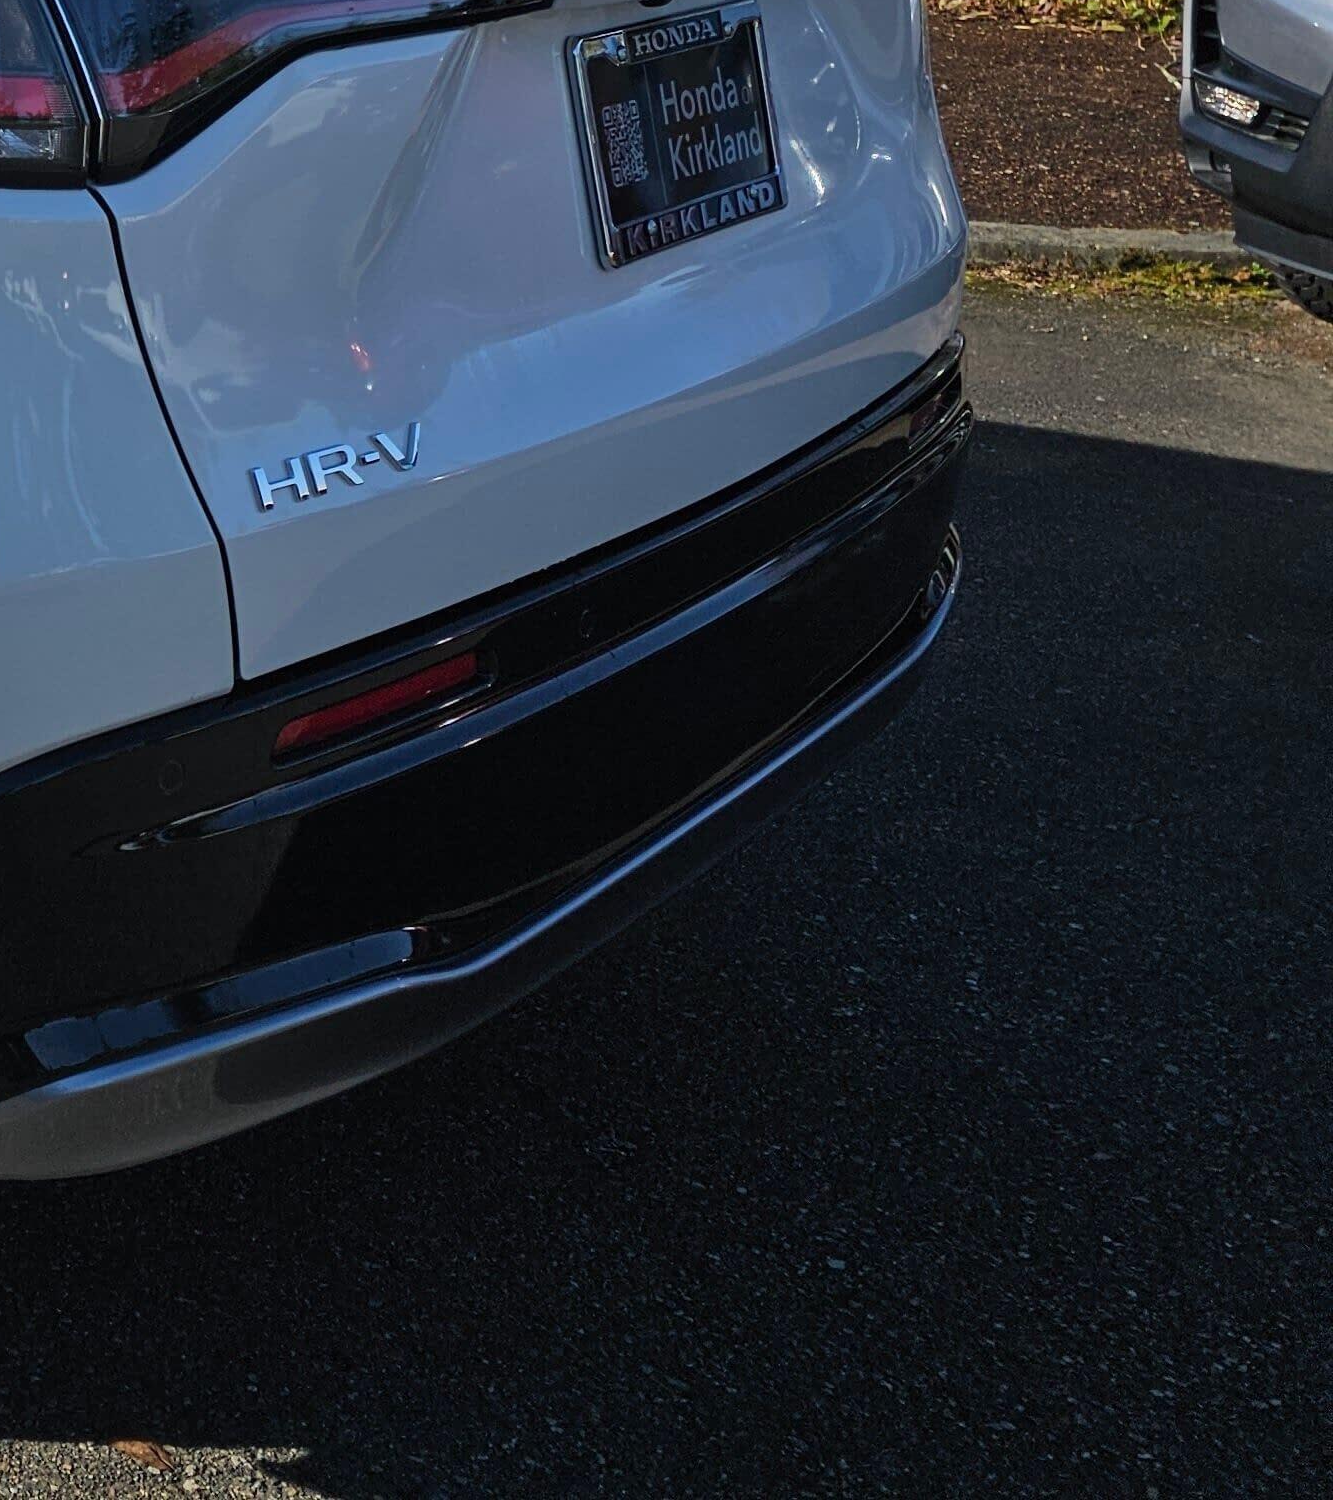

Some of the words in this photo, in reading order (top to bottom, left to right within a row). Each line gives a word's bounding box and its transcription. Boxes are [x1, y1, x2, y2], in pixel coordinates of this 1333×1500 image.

[634, 19, 717, 56] HONDA
[659, 66, 739, 125] Honda
[668, 111, 763, 181] Kirkland
[249, 422, 421, 511] HR-V
